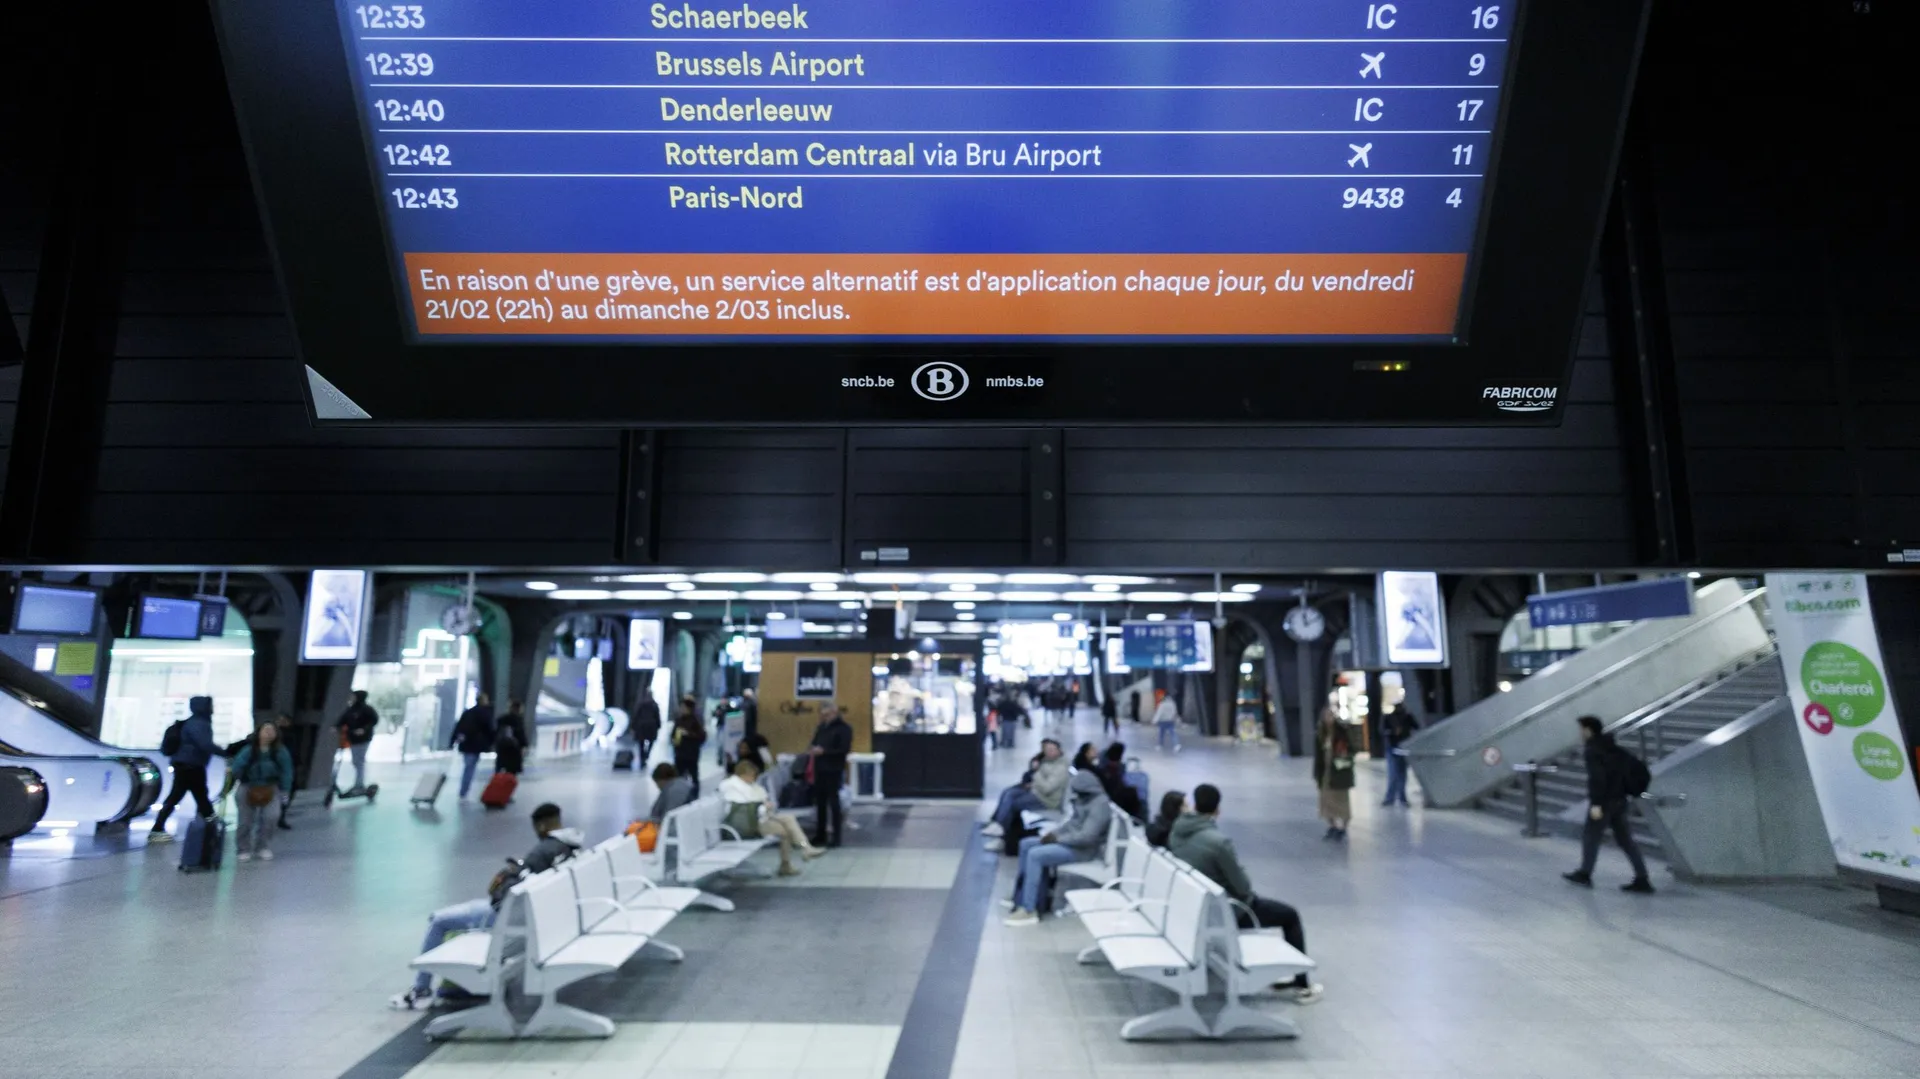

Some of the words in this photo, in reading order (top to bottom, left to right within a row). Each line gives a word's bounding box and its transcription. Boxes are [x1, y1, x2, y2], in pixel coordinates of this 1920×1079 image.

[355, 5, 425, 29] 12:33
[650, 3, 809, 29] Schaerbeek
[1366, 4, 1398, 29] IC
[1471, 5, 1500, 29] 16
[365, 52, 434, 76] 12:39
[655, 51, 763, 77] Brussels
[770, 51, 865, 81] Airport
[1468, 53, 1486, 76] 9
[374, 100, 445, 122] 12:40
[660, 98, 833, 122] Denderleeuw
[1354, 98, 1384, 122] IC
[1456, 100, 1484, 122] 17
[383, 144, 452, 166] 12:42
[665, 143, 799, 166] Rotterdam
[805, 143, 914, 166] Centraal
[922, 143, 957, 167] via
[965, 143, 1006, 167] Bru
[1013, 143, 1102, 171] Airport
[1451, 145, 1474, 166] 11
[392, 187, 459, 209] 12:43
[669, 186, 803, 209] Paris-Nord
[1342, 187, 1405, 209] 9438
[1445, 187, 1463, 208] 4
[420, 270, 450, 291] En
[456, 269, 528, 292] raison
[535, 270, 600, 292] d'une
[606, 270, 680, 300] grève,
[686, 276, 715, 292] un
[721, 270, 806, 292] service
[811, 270, 919, 292] alternatif
[924, 272, 960, 292] est
[966, 270, 1117, 297] d'application
[1123, 270, 1211, 297] chaque
[1214, 270, 1268, 297] jour,
[1274, 270, 1304, 292] du
[1311, 270, 1415, 292] vendredi
[426, 298, 490, 319] 21/02
[495, 297, 554, 323] (22h)
[560, 303, 589, 320] au
[594, 295, 710, 320] dimanche
[715, 299, 770, 320] 2/03
[776, 298, 851, 320] inclus.
[841, 375, 895, 388] sncb.be
[986, 375, 1044, 388] nmbs.be
[1482, 386, 1558, 399] FABRICOM
[798, 676, 833, 692] JAVA
[1810, 679, 1876, 696] Charleroi
